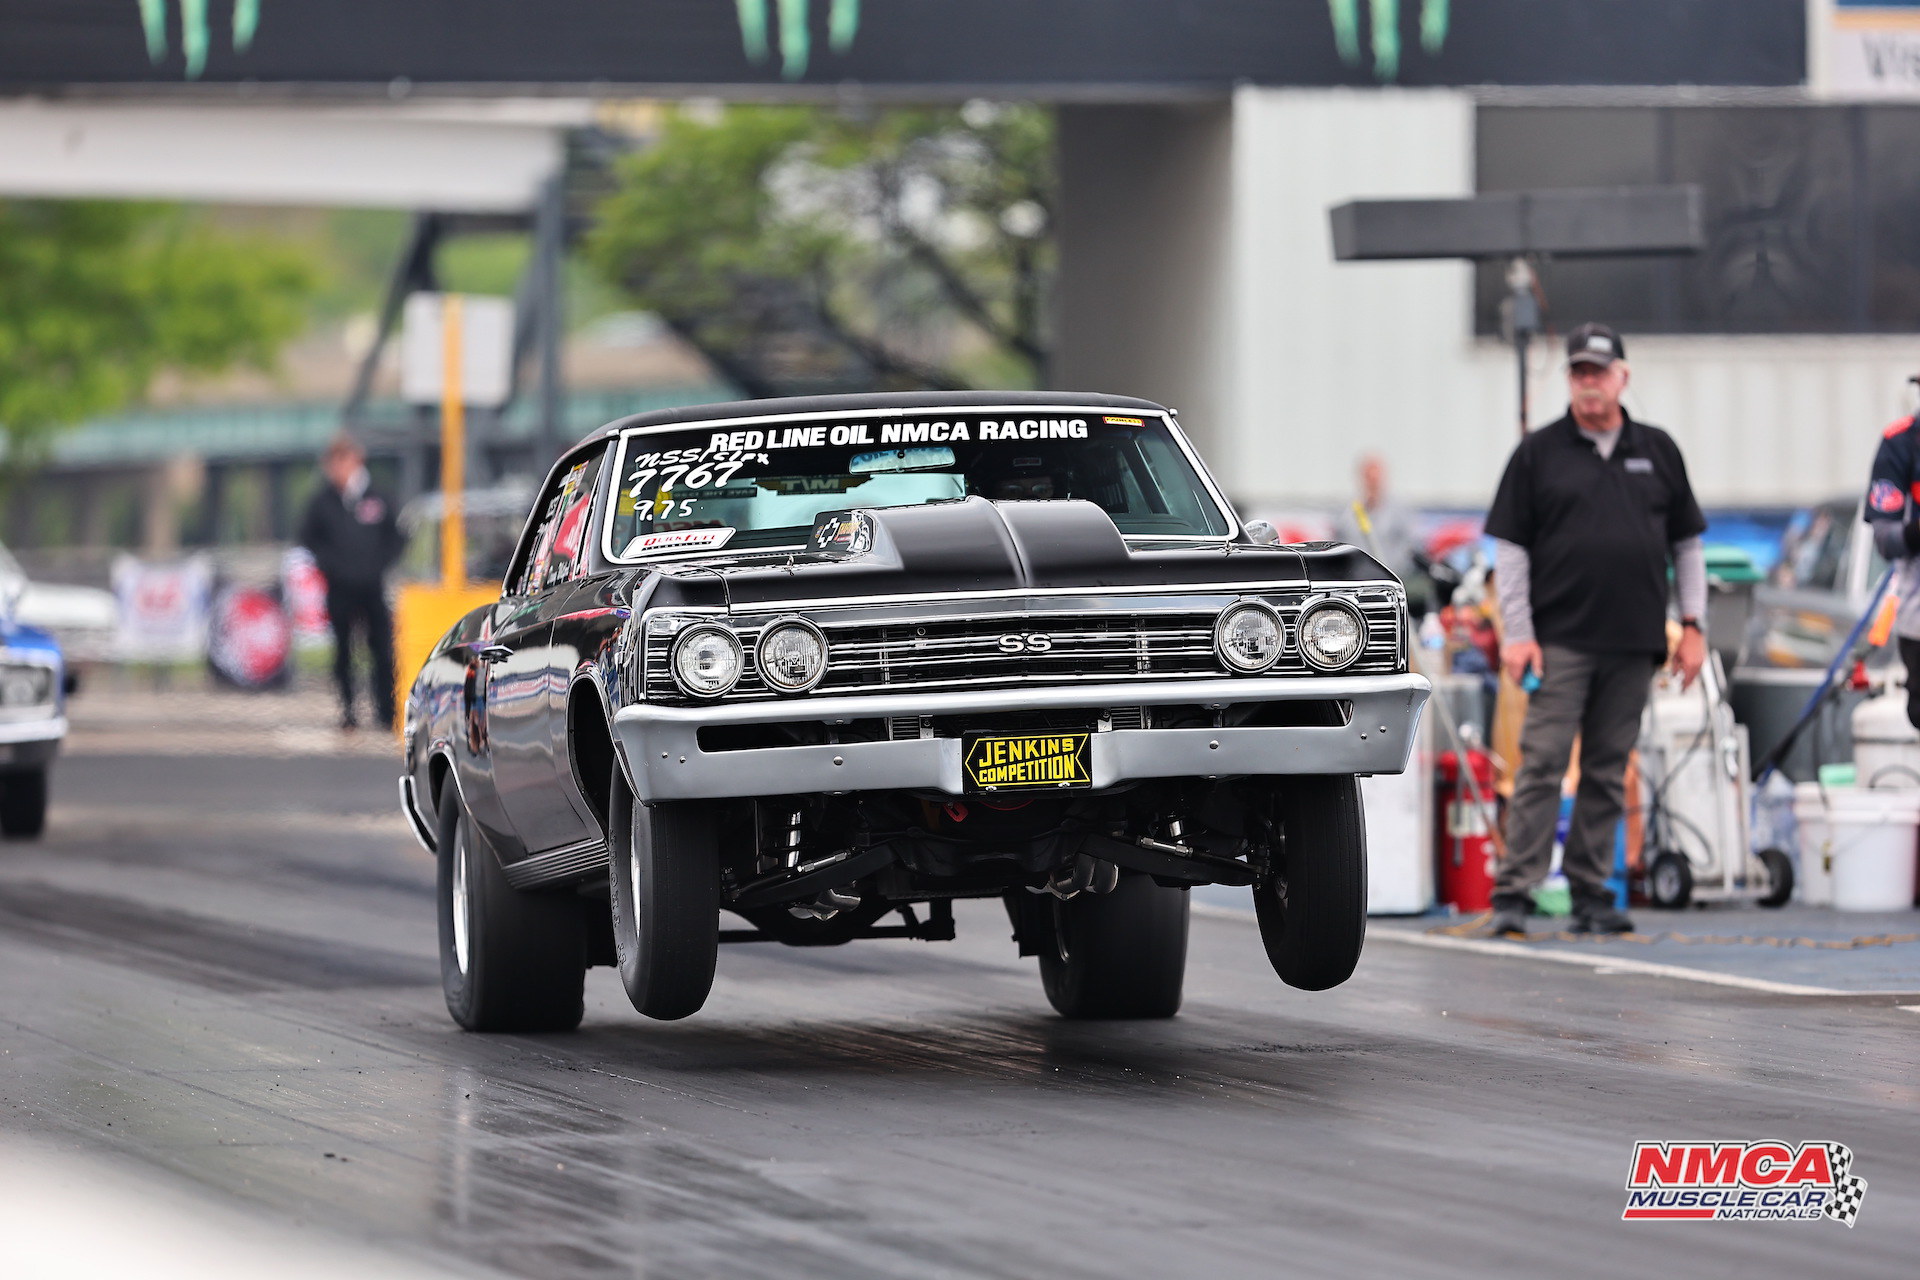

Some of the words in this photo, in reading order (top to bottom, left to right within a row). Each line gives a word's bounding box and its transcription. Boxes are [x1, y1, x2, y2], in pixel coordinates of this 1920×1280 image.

[709, 431, 764, 453] RED
[766, 427, 827, 449] LINE
[829, 425, 875, 446] OIL
[880, 421, 970, 443] NMCA
[979, 419, 1088, 440] RACING
[628, 460, 744, 498] 7767
[633, 499, 697, 521] 9.75
[998, 632, 1052, 653] SS
[978, 738, 1075, 768] JENKINS
[978, 752, 1075, 783] COMPETITION
